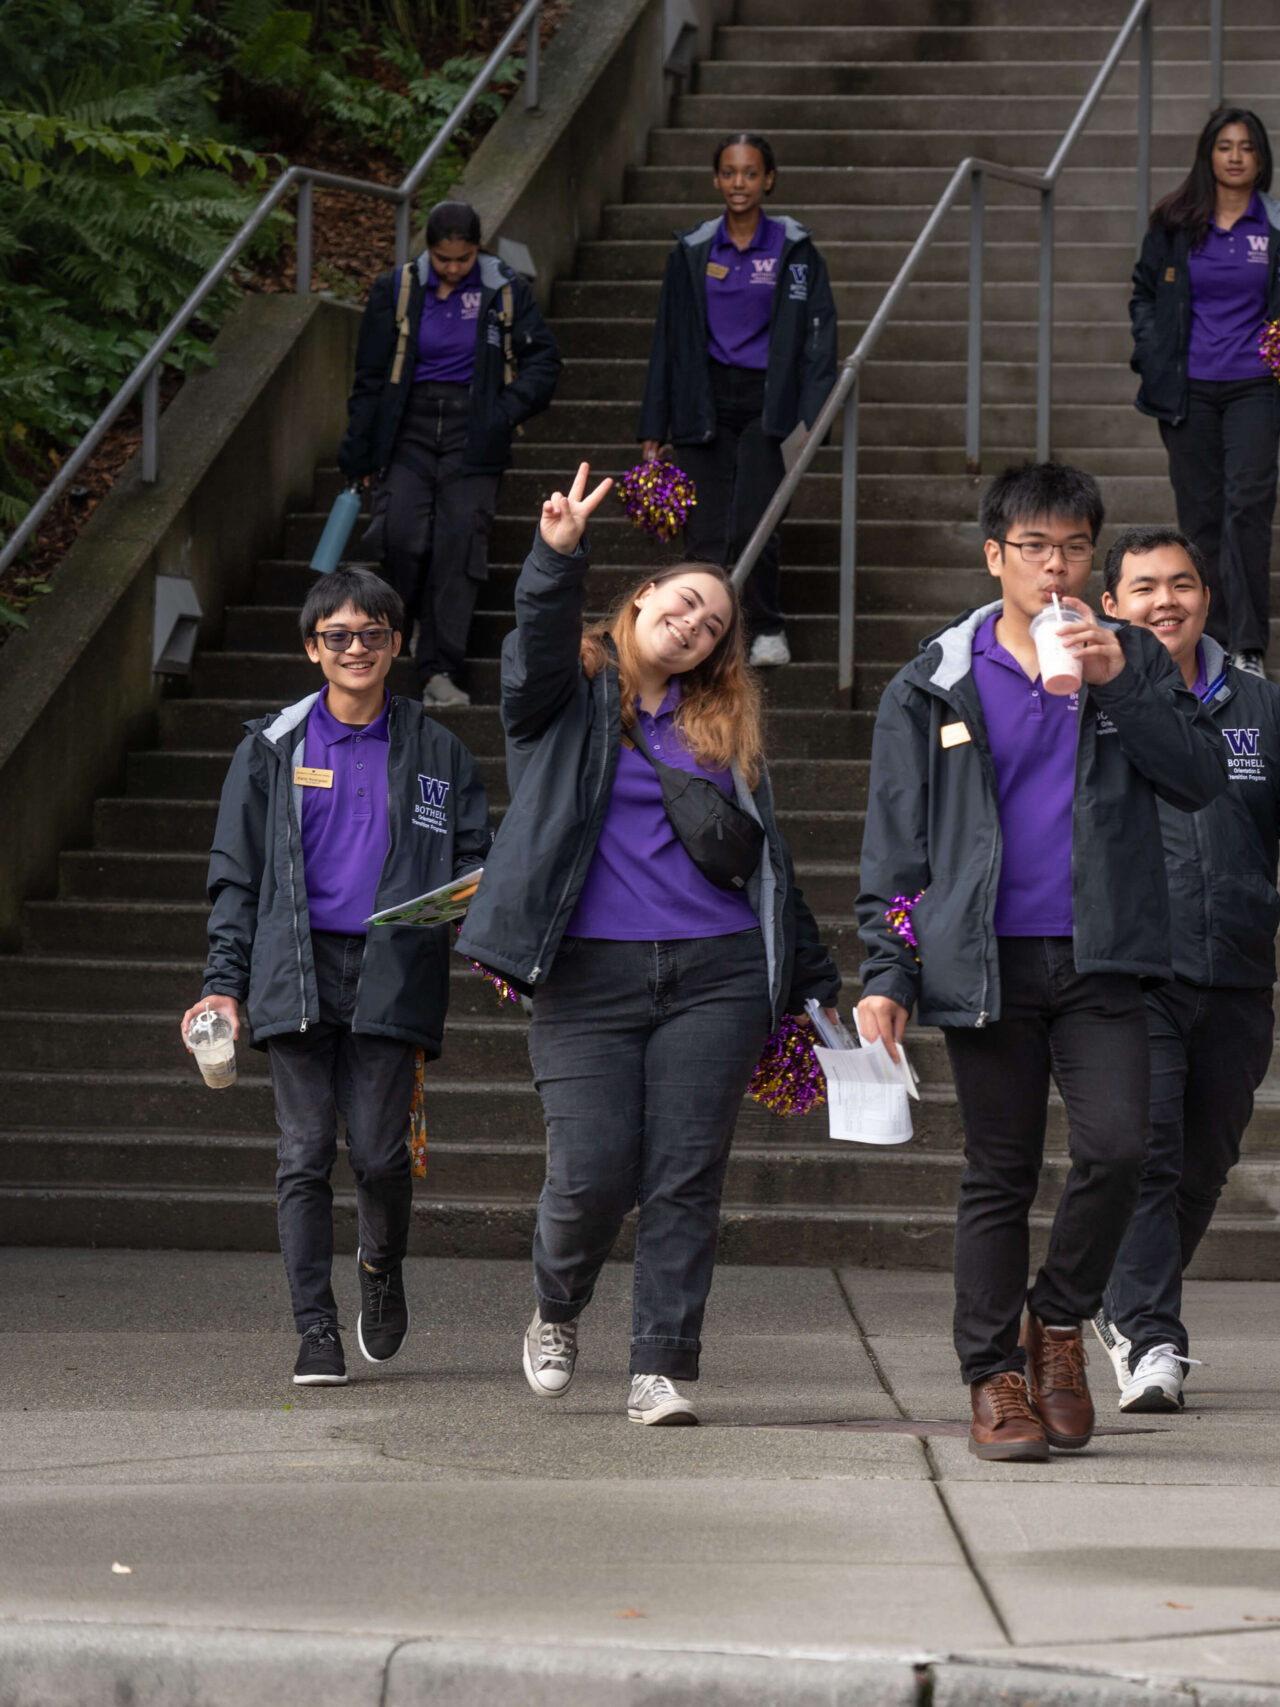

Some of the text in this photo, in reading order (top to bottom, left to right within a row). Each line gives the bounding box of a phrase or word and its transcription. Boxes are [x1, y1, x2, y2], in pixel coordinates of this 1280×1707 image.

[1246, 235, 1269, 251] W
[752, 258, 777, 272] W
[1222, 728, 1260, 755] W
[1227, 758, 1265, 768] BOTHELL
[417, 773, 450, 808] W
[414, 804, 448, 821] BOTHELL
